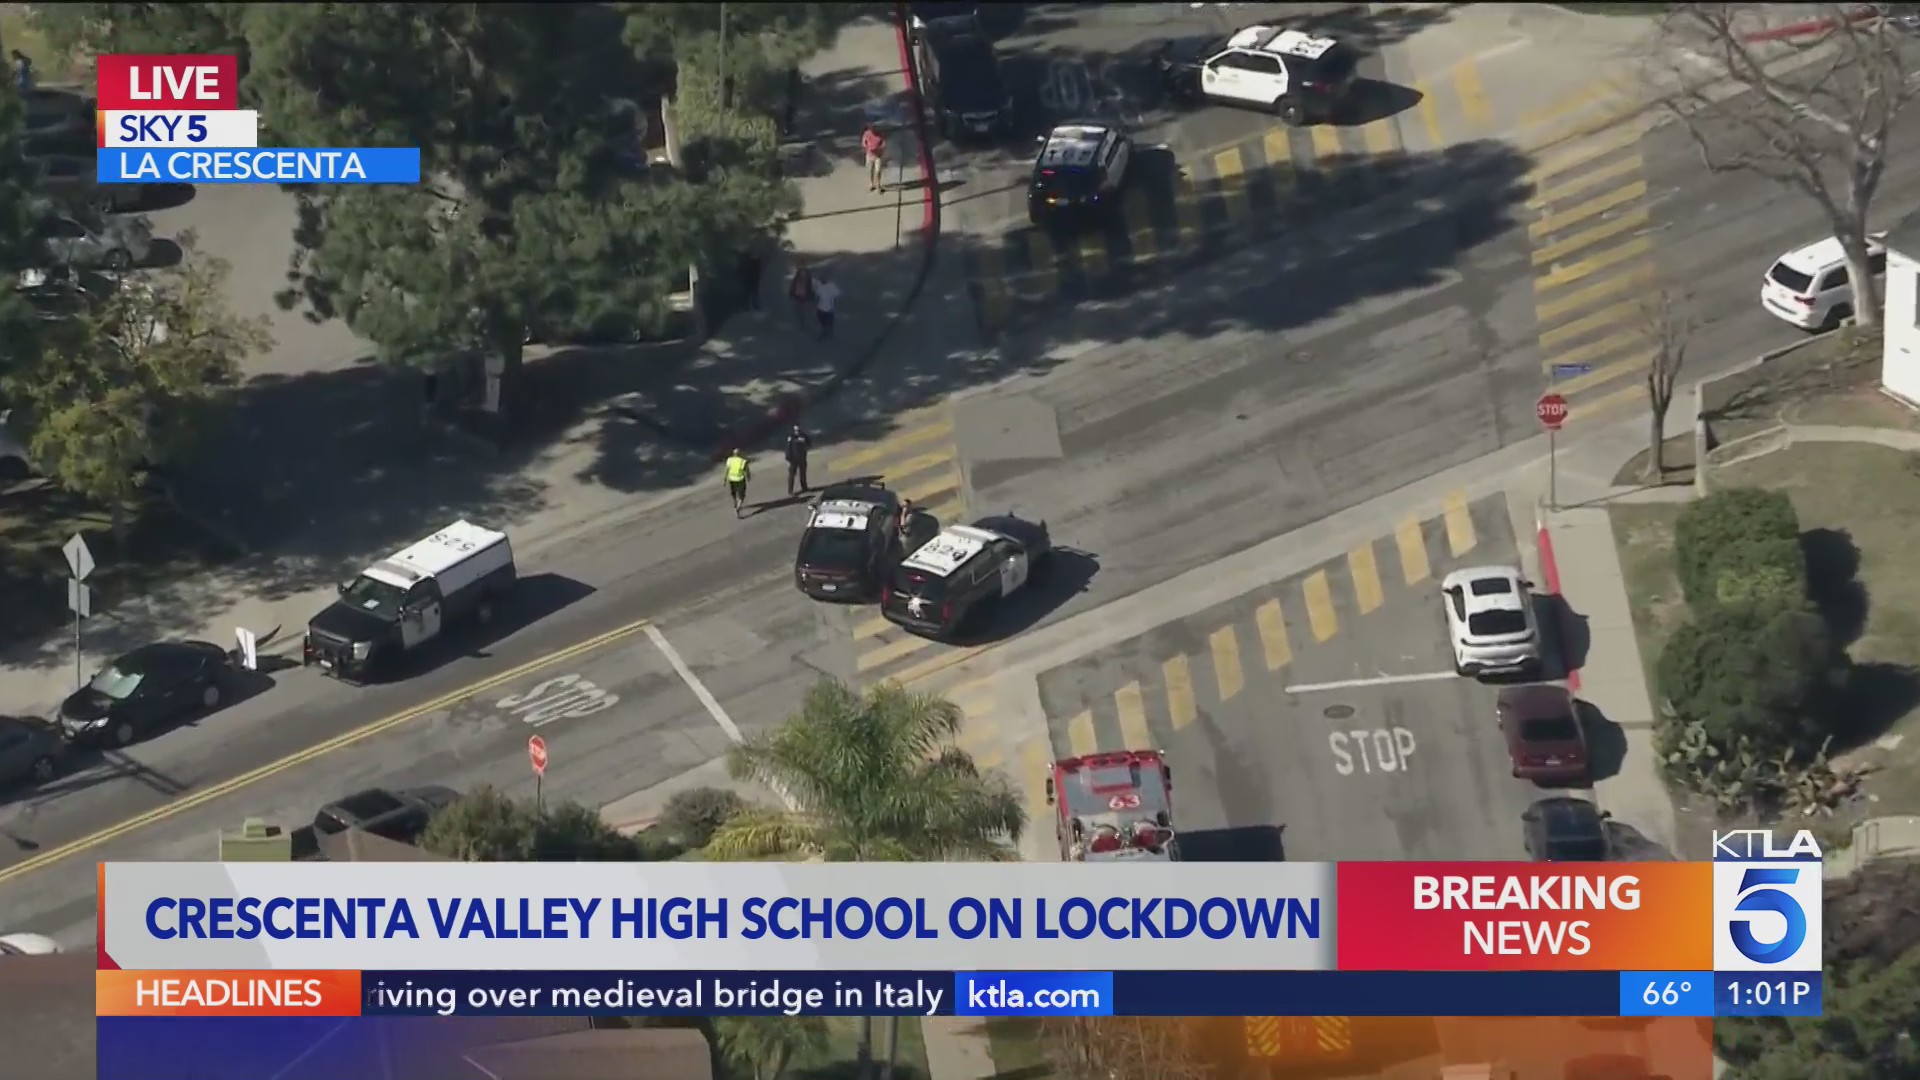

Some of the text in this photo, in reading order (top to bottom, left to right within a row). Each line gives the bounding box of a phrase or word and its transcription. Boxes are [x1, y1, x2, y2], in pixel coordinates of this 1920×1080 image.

[1538, 403, 1567, 416] STOP
[1329, 727, 1416, 775] STOP
[1109, 794, 1141, 810] 63
